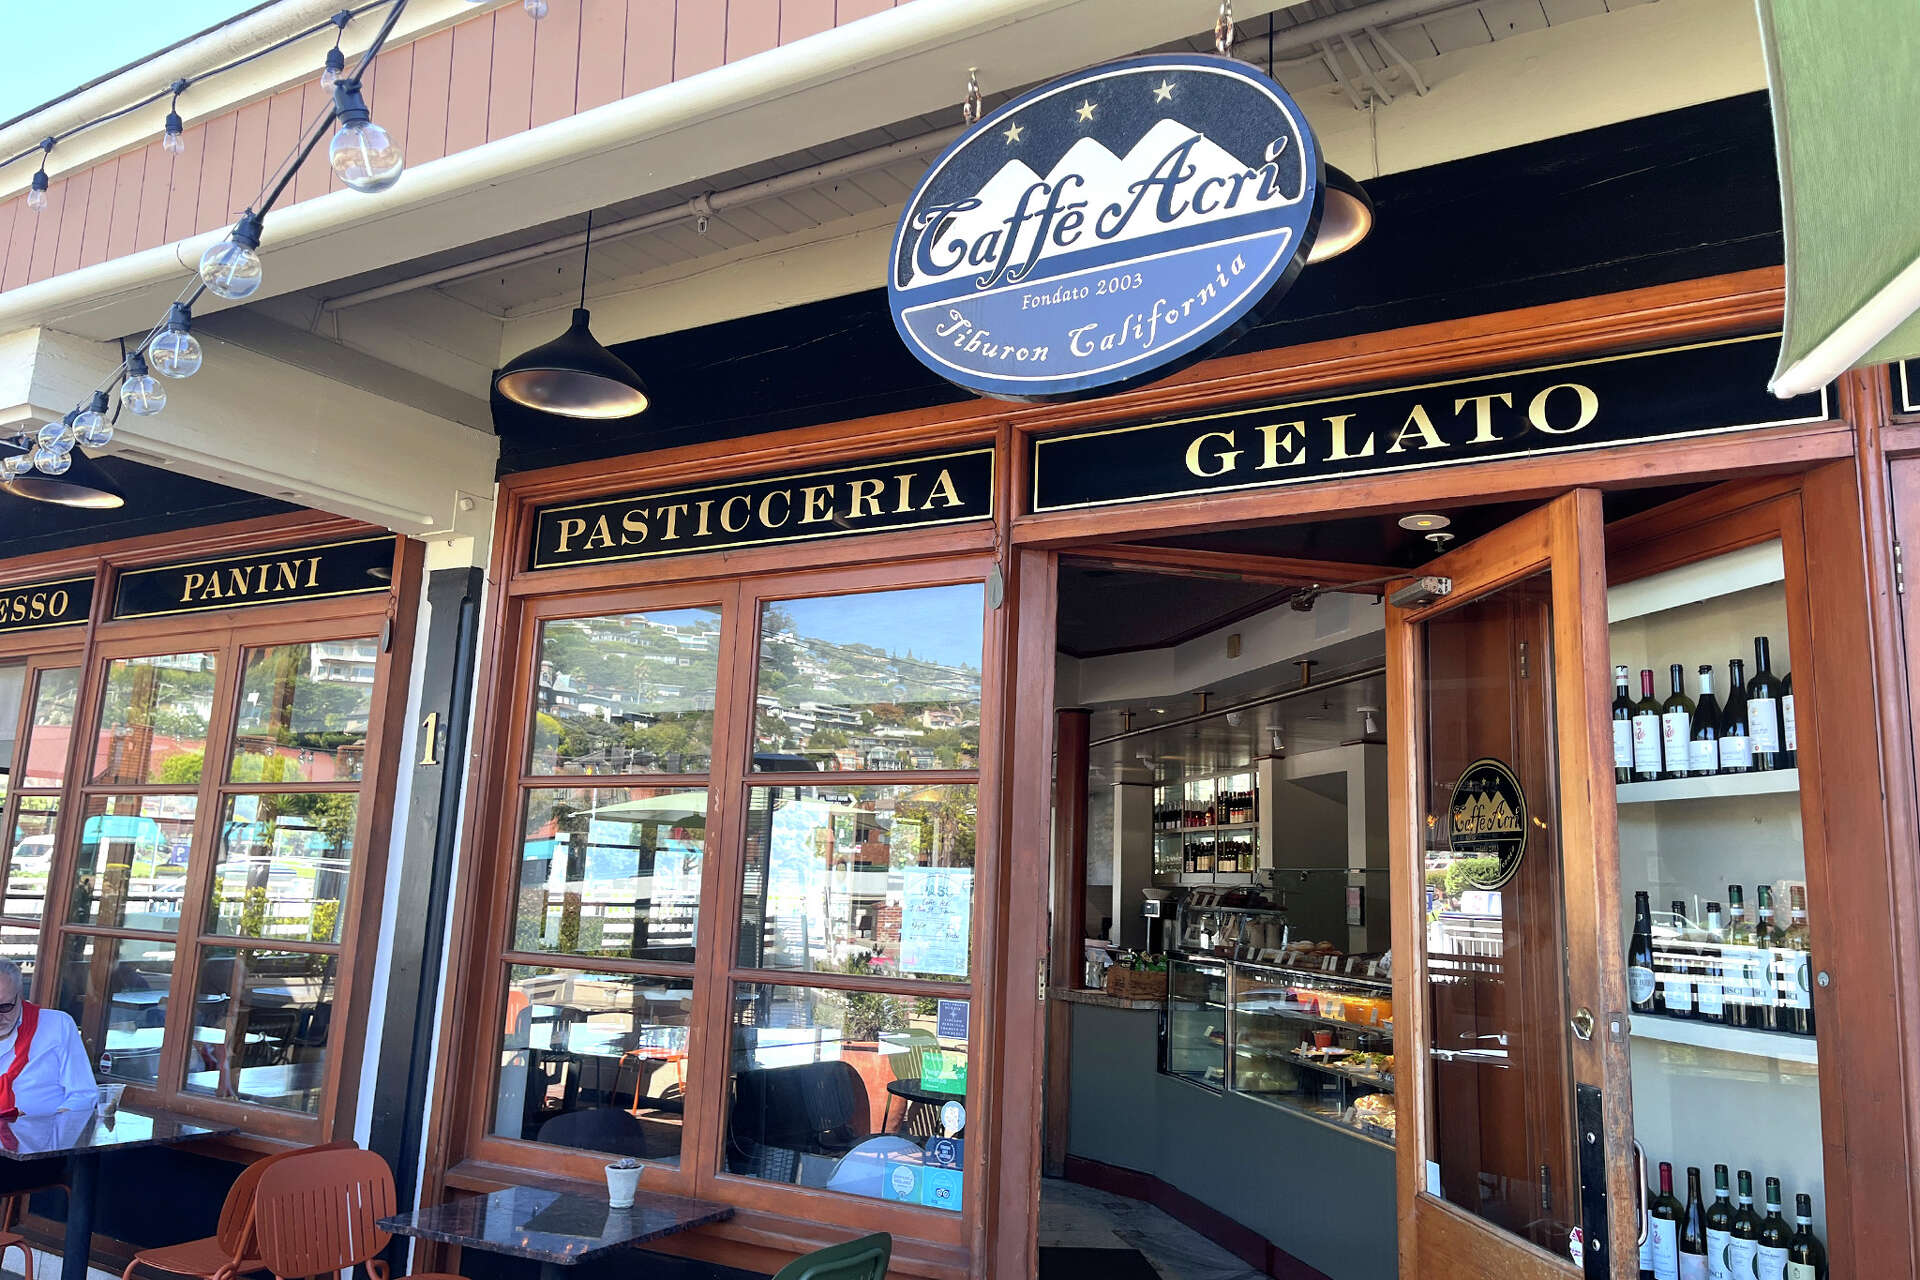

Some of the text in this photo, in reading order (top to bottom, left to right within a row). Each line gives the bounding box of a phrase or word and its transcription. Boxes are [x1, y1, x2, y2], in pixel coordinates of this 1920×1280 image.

[1094, 133, 1289, 241] Acri
[936, 253, 1247, 363] Tiburon California
[1021, 273, 1144, 311] Fondato 2003
[1185, 383, 1599, 478] GELATO
[553, 468, 965, 554] PASTICCERIA
[179, 556, 323, 603] PANINI
[419, 712, 440, 766] 1
